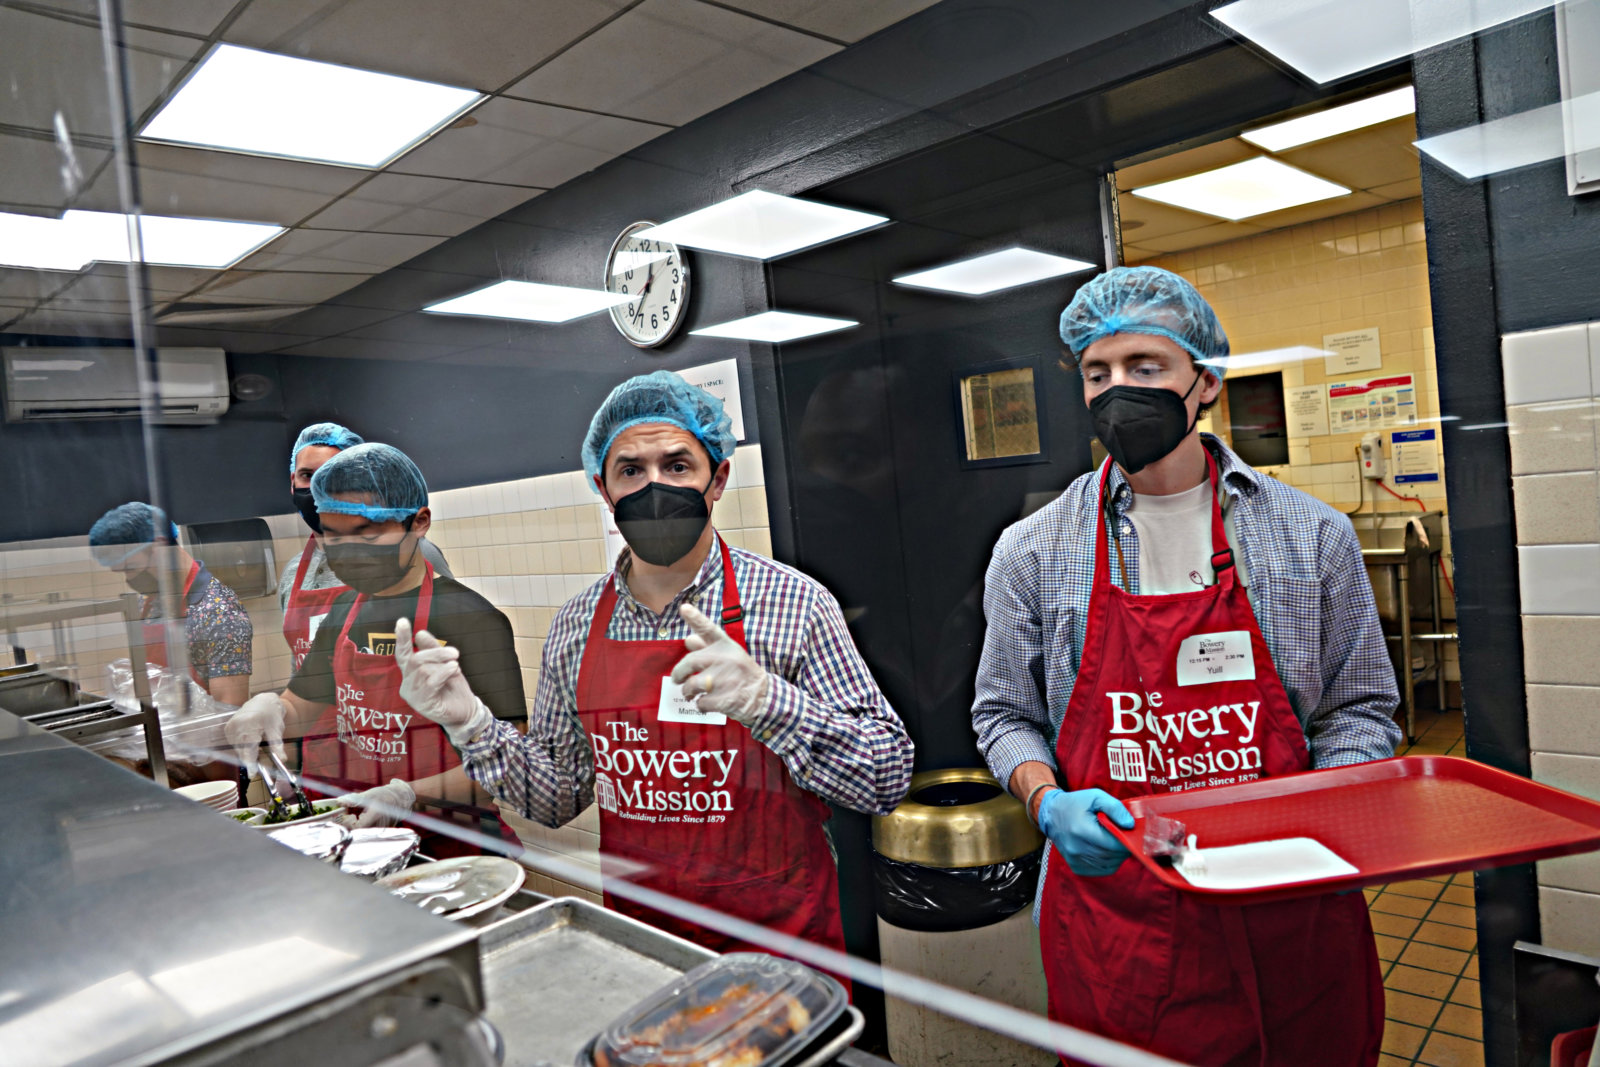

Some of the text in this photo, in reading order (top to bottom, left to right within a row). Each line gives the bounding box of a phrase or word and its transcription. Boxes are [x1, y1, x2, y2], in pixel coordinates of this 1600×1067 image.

[640, 239, 652, 253] 12
[655, 241, 660, 253] 1
[672, 268, 679, 284] 3
[670, 289, 677, 304] 4
[629, 303, 635, 317] 8
[663, 306, 669, 321] 5
[639, 314, 644, 328] 7
[651, 314, 658, 329] 6
[344, 683, 364, 701] he
[347, 720, 408, 755] ssion
[606, 721, 649, 742] The
[590, 732, 739, 787] Bowery
[1184, 780, 1206, 790] Lives
[1208, 777, 1235, 787] Since
[616, 778, 734, 812] Mission
[618, 810, 726, 823] Rebuilding Lives Since 1879
